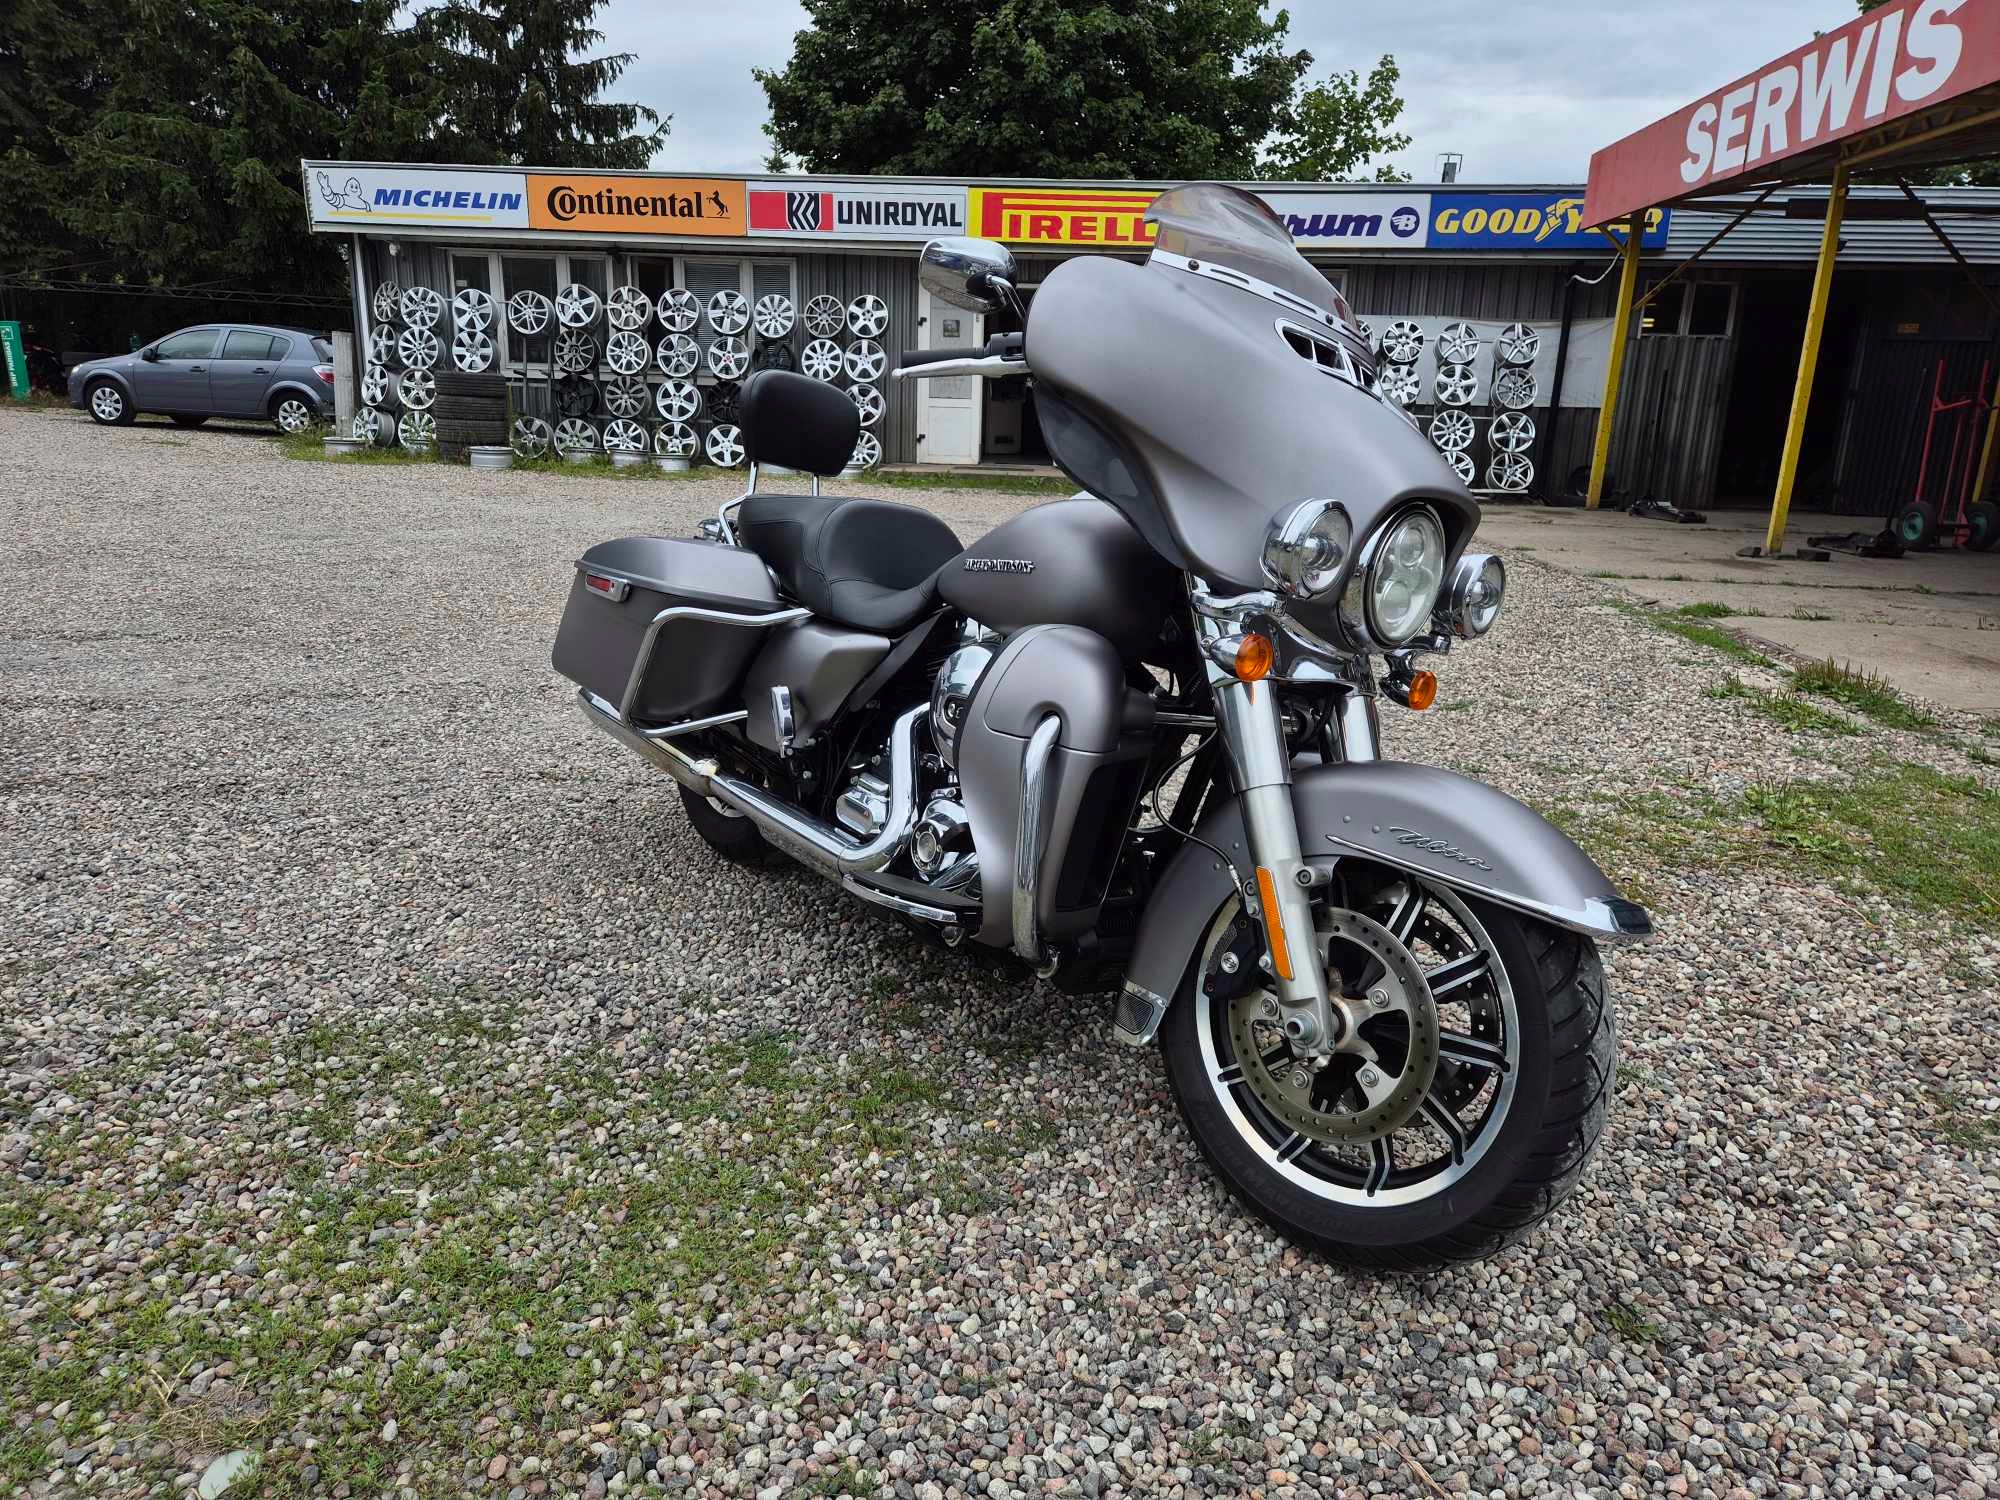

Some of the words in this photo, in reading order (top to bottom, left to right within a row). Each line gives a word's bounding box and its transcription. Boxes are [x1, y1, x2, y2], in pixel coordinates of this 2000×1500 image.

[1680, 0, 1967, 184] SERWIS
[374, 188, 522, 211] MICHELIN
[547, 185, 704, 222] Continental
[837, 200, 963, 227] UNIROYAL
[981, 191, 1158, 242] PIRELL
[1278, 214, 1383, 237] rum
